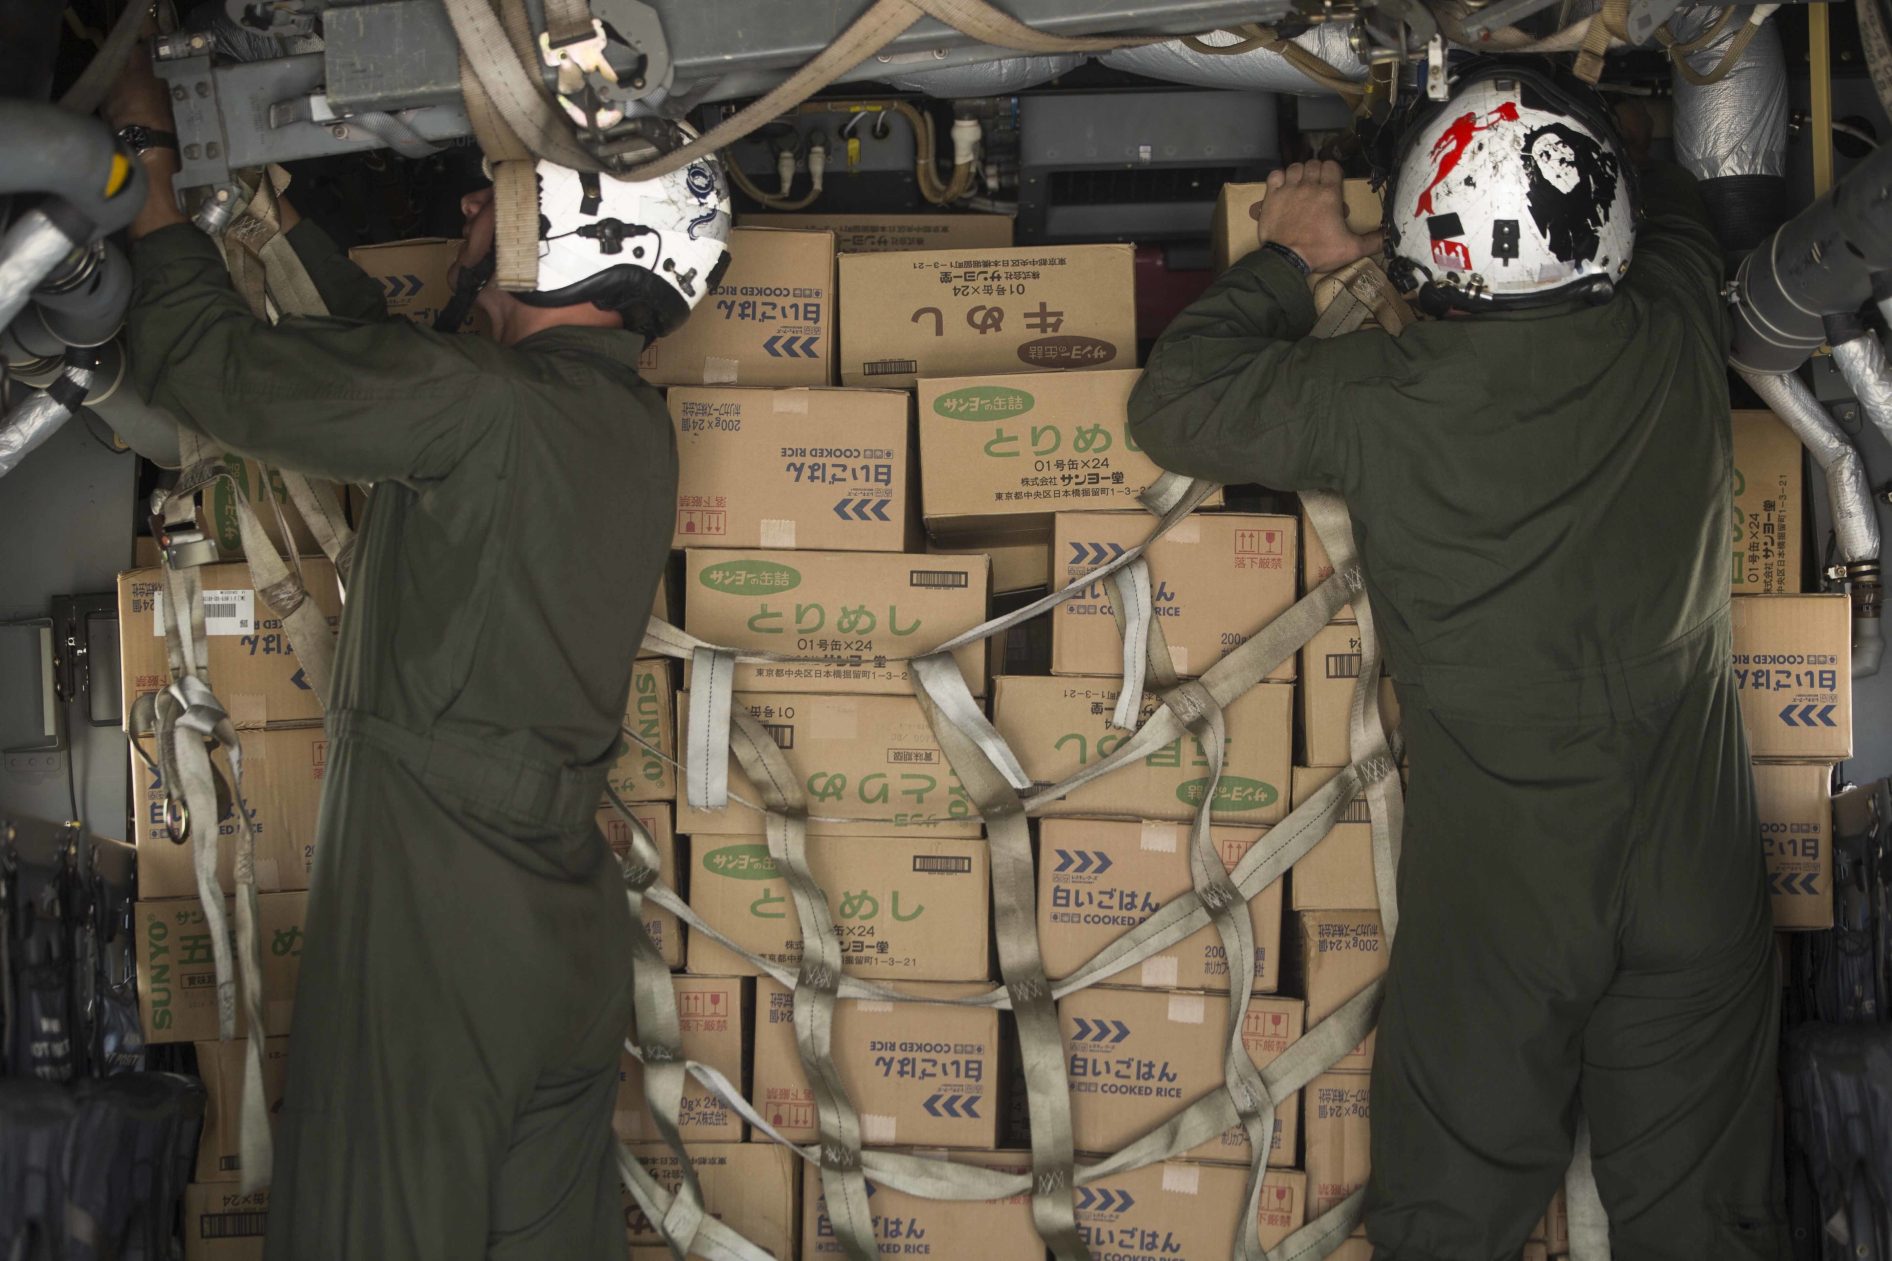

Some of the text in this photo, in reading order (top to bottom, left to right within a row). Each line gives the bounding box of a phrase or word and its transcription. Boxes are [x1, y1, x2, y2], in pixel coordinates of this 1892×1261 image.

[939, 270, 1041, 284] 株式会社 サンヨー堂
[740, 286, 791, 298] COOKED
[952, 282, 1026, 297] 01号缶×24
[716, 300, 821, 326] 白いごはん
[909, 301, 1065, 337] 牛めし
[1027, 344, 1108, 360] サンヨーの缶詰
[943, 396, 1024, 412] サンヨーの缶詰
[780, 447, 861, 460] COOKED RICE
[1034, 457, 1110, 473] 01号缶×24
[784, 461, 892, 487] 白いごはん
[1020, 472, 1125, 487] 株式会社 サンヨー堂
[679, 495, 727, 508] 落下厳禁
[1762, 500, 1776, 559] サンヨー堂
[1747, 512, 1760, 584] 01号缶×24
[1233, 556, 1283, 570] 落下厳禁
[709, 570, 791, 587] サンヨーの缶詰
[746, 602, 922, 637] とりめし
[1154, 606, 1181, 618] RICE
[797, 638, 873, 653] 01号缶×24
[1753, 654, 1805, 666] COOKED
[636, 673, 664, 781] SUNYO
[892, 749, 934, 762] 賞味期限
[806, 771, 937, 805] とりめ
[1186, 785, 1268, 802] サンヨーの詰
[750, 886, 925, 922] とめし
[1052, 884, 1161, 913] 白いごはん
[1083, 913, 1137, 927] COOKED
[147, 920, 173, 1031] SUNYO
[869, 1040, 952, 1055] COOKED RICE
[874, 1056, 983, 1083] 白いごはん
[1069, 1053, 1178, 1084] 白いごはん
[1100, 1082, 1183, 1099] COOKED RICE
[903, 1243, 931, 1256] RICE
